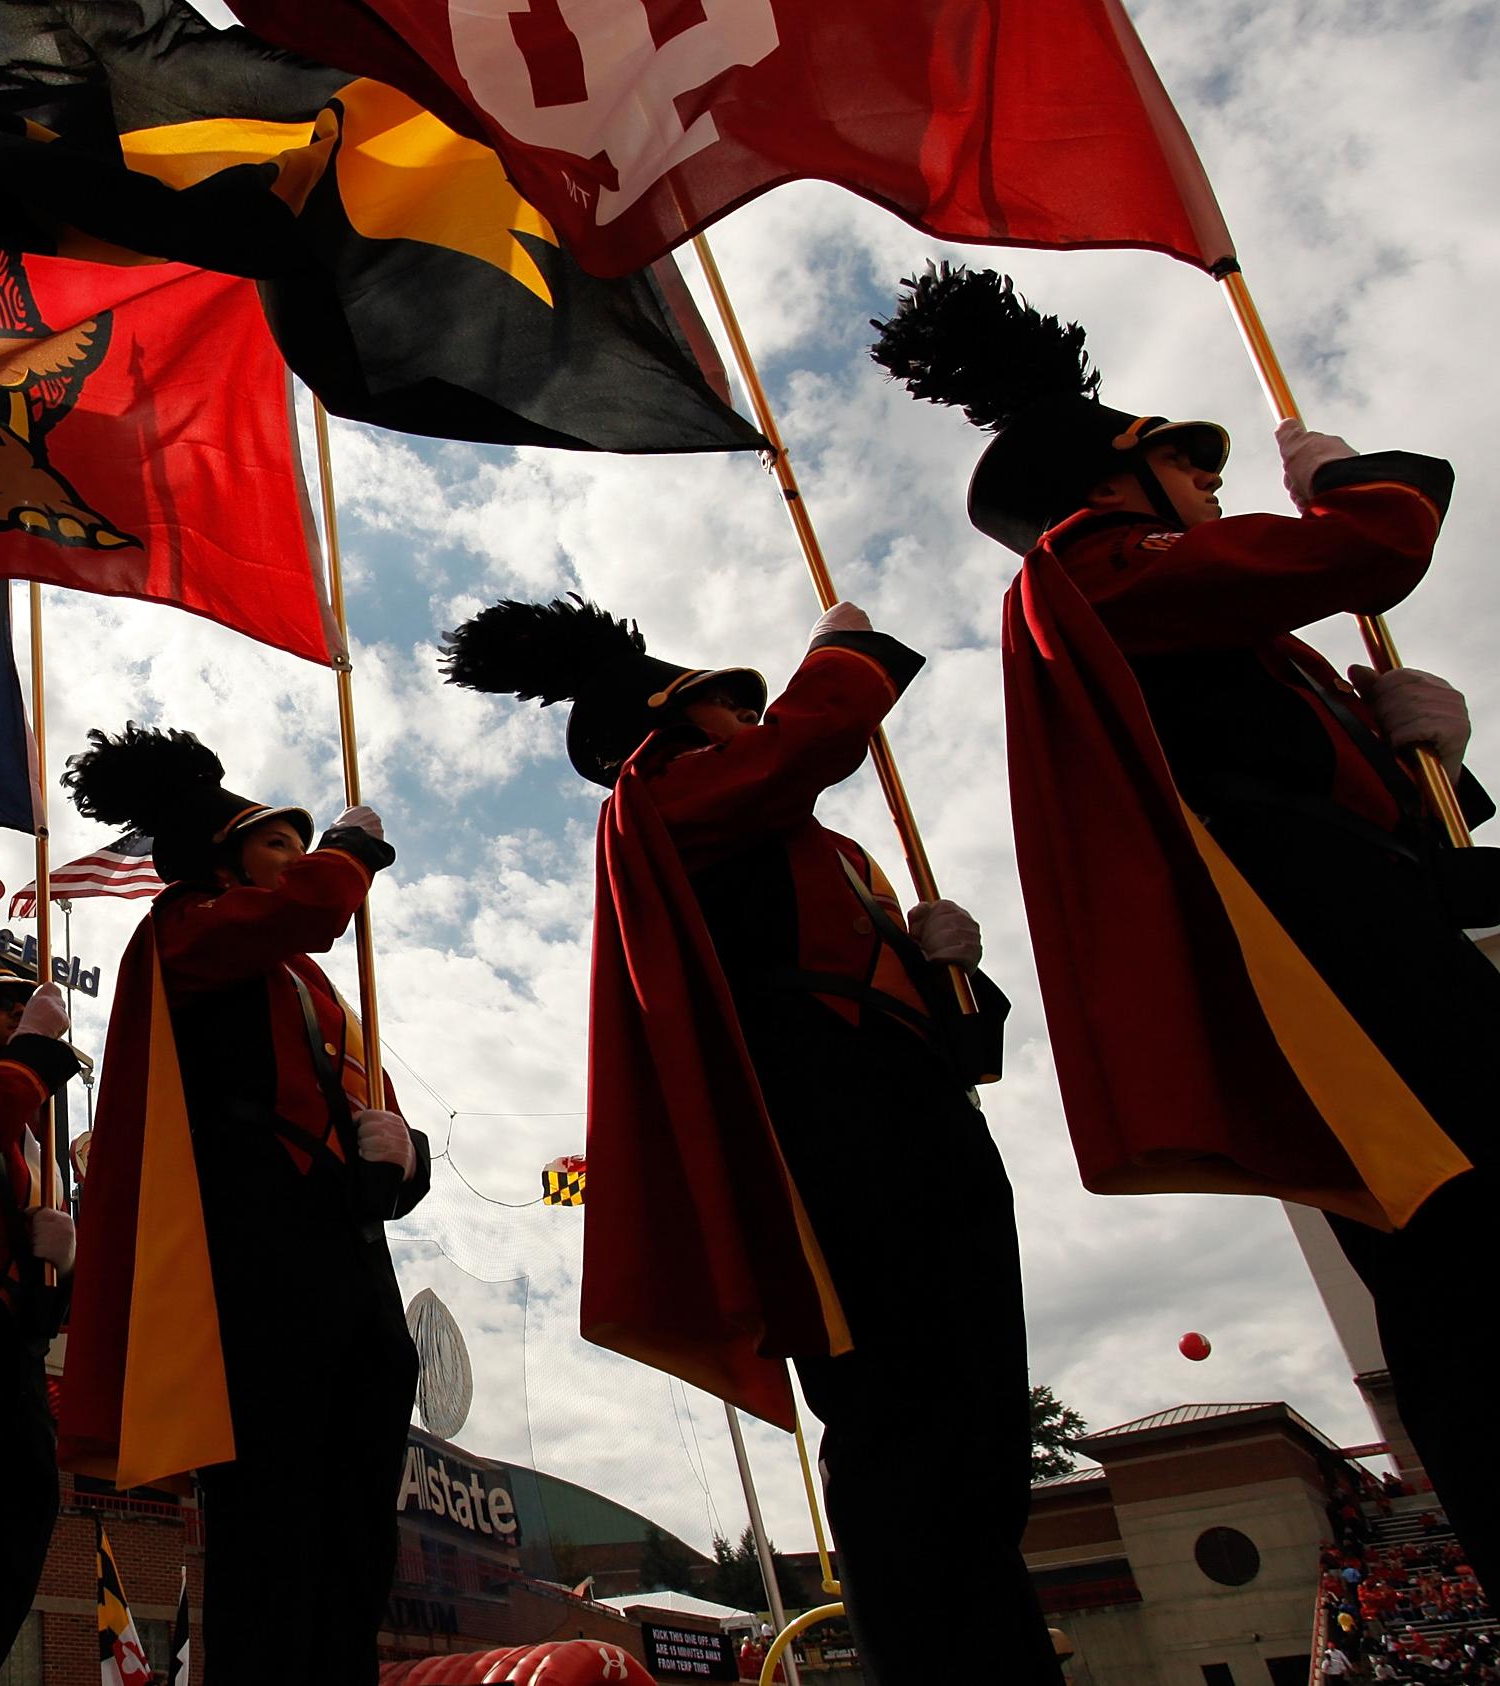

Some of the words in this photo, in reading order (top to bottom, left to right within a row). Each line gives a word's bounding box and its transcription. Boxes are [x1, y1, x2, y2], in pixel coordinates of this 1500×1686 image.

[20, 933, 101, 998] Feld
[396, 1445, 518, 1535] Allstate
[652, 1629, 668, 1640] KICK
[669, 1631, 683, 1642] THIS
[684, 1634, 697, 1644] ONE
[711, 1638, 720, 1648] WE
[656, 1644, 668, 1654] ARE
[705, 1650, 721, 1661] AWAY
[658, 1658, 676, 1669] FROM
[677, 1660, 692, 1671] TERP
